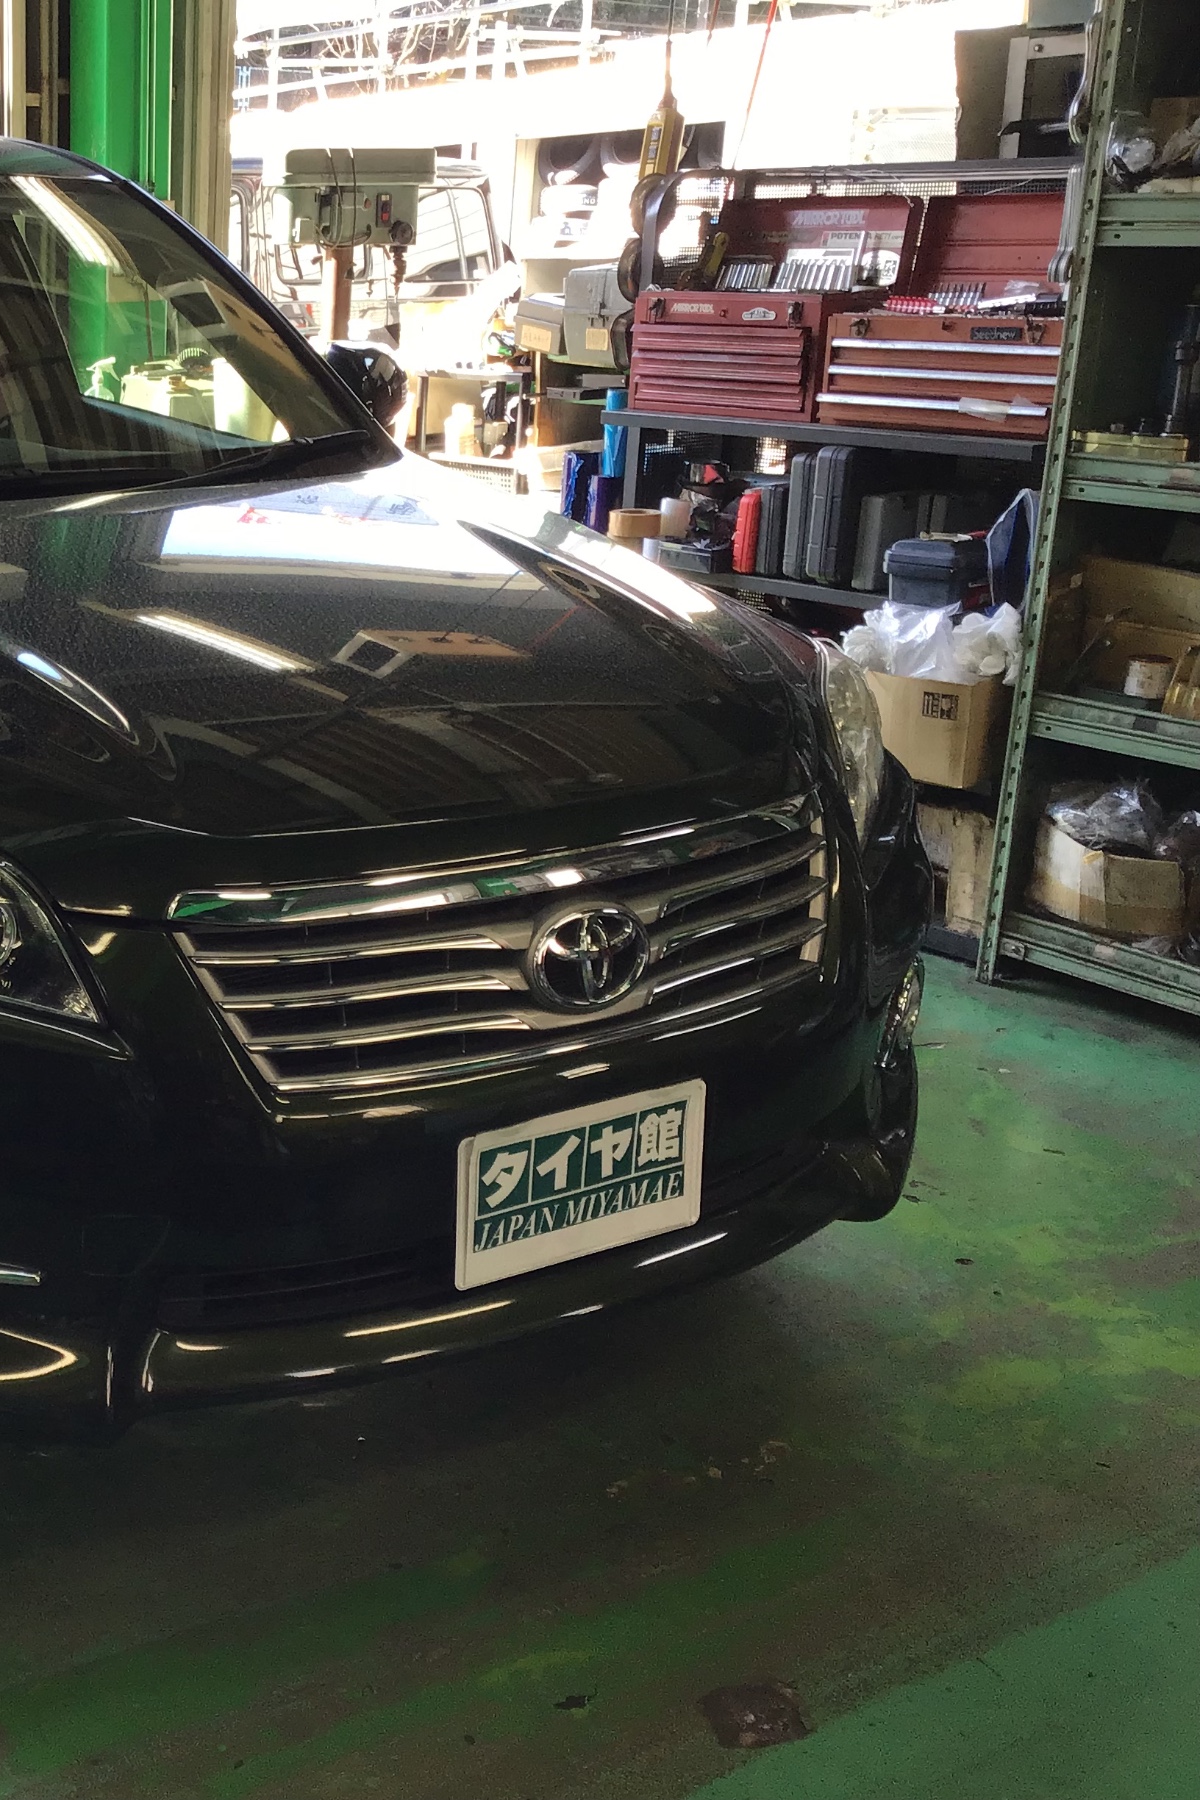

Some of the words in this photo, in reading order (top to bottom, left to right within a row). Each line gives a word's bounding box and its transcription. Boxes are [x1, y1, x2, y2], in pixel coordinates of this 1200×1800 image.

[830, 232, 872, 240] POTENA
[481, 1107, 682, 1209] タイヤ館
[475, 1204, 559, 1251] JAPAN
[562, 1171, 683, 1228] MIYAMAE
